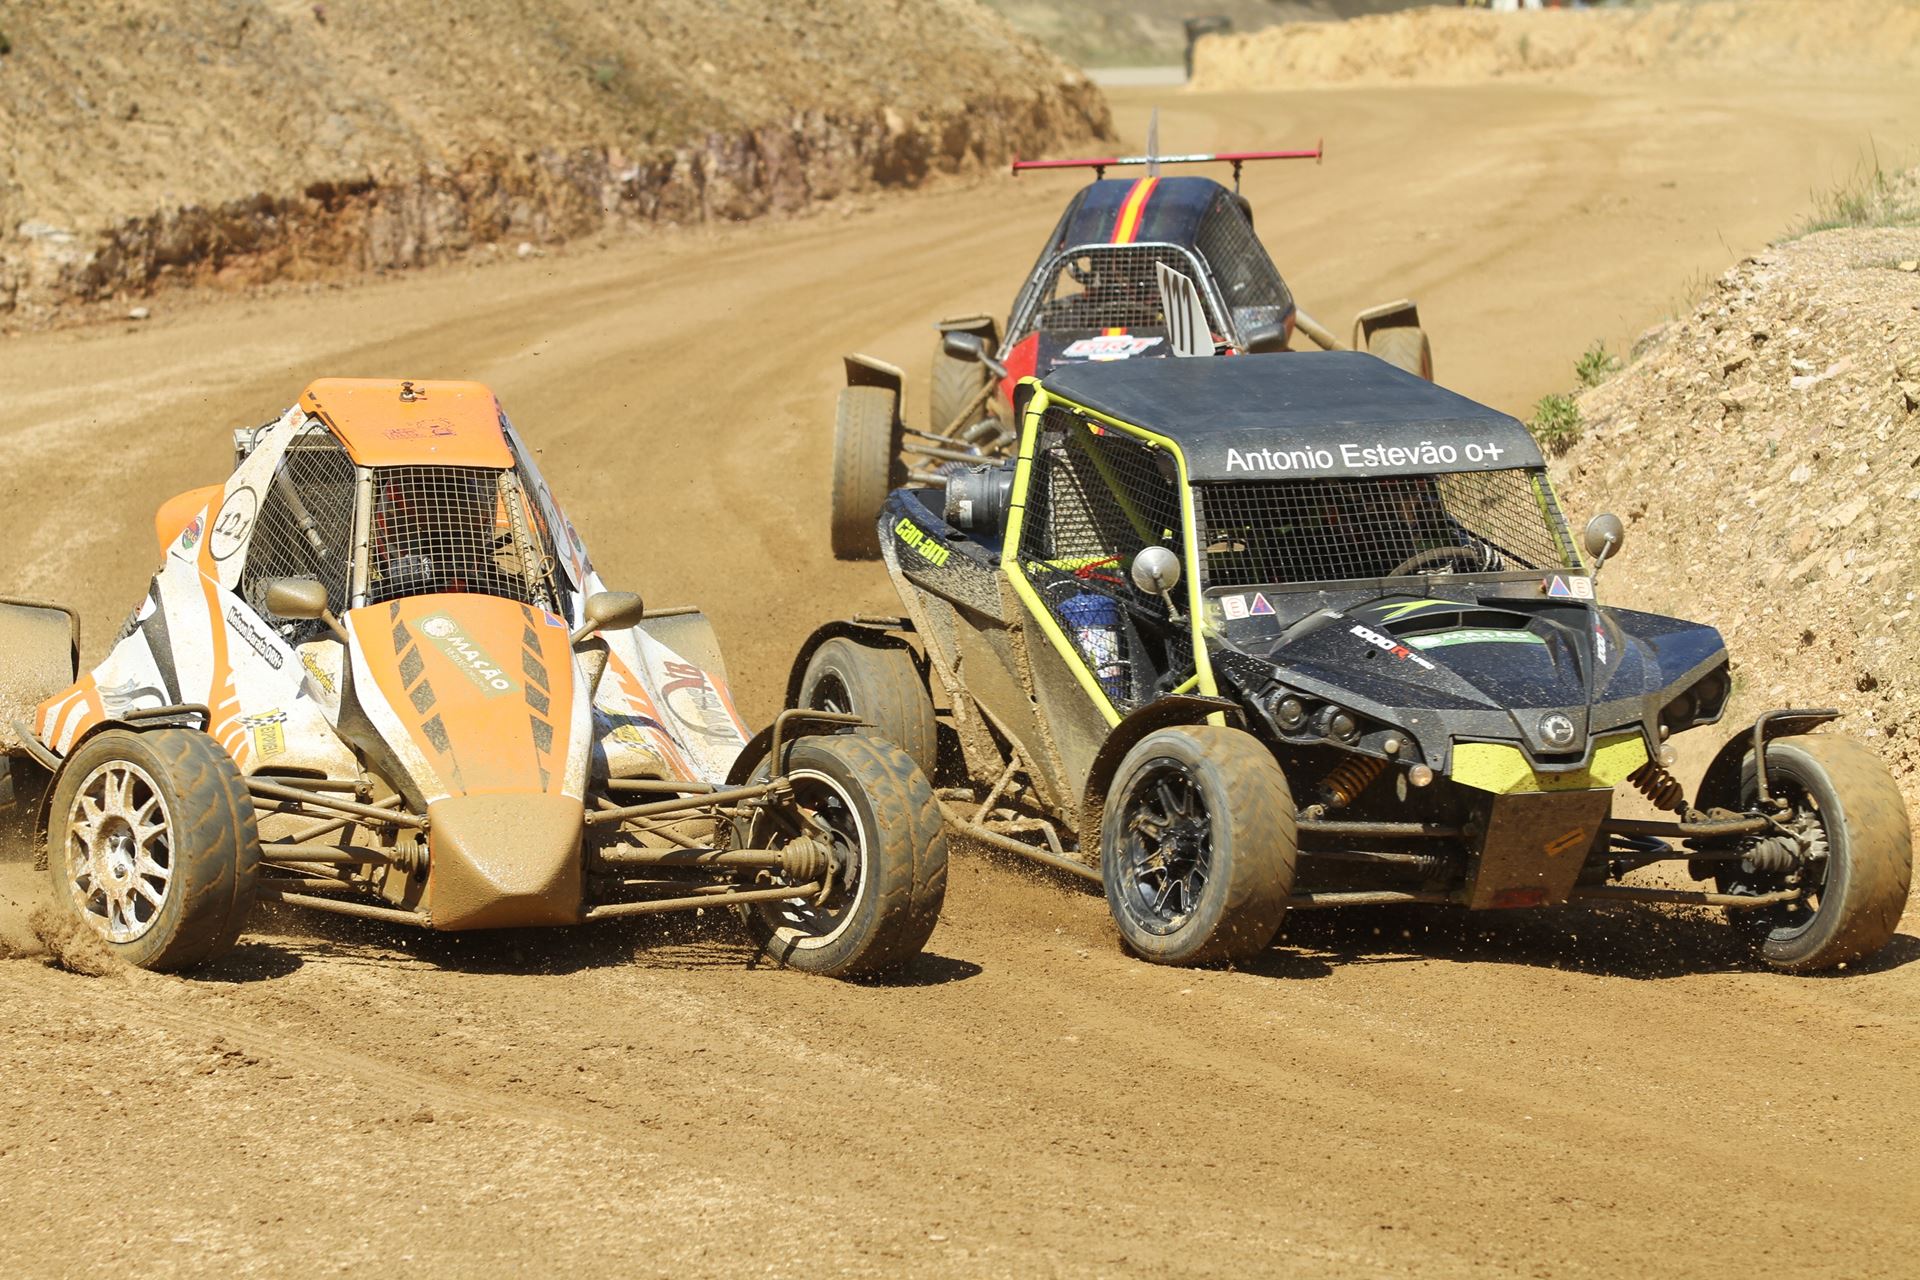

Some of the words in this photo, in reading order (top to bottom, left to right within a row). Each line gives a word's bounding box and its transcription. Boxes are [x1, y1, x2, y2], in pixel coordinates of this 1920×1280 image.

[1225, 446, 1334, 472] Antonio
[1339, 441, 1458, 468] Estevão
[215, 511, 252, 540] 121
[895, 517, 950, 567] can-am
[227, 605, 249, 638] Nelson
[245, 624, 267, 658] Barata
